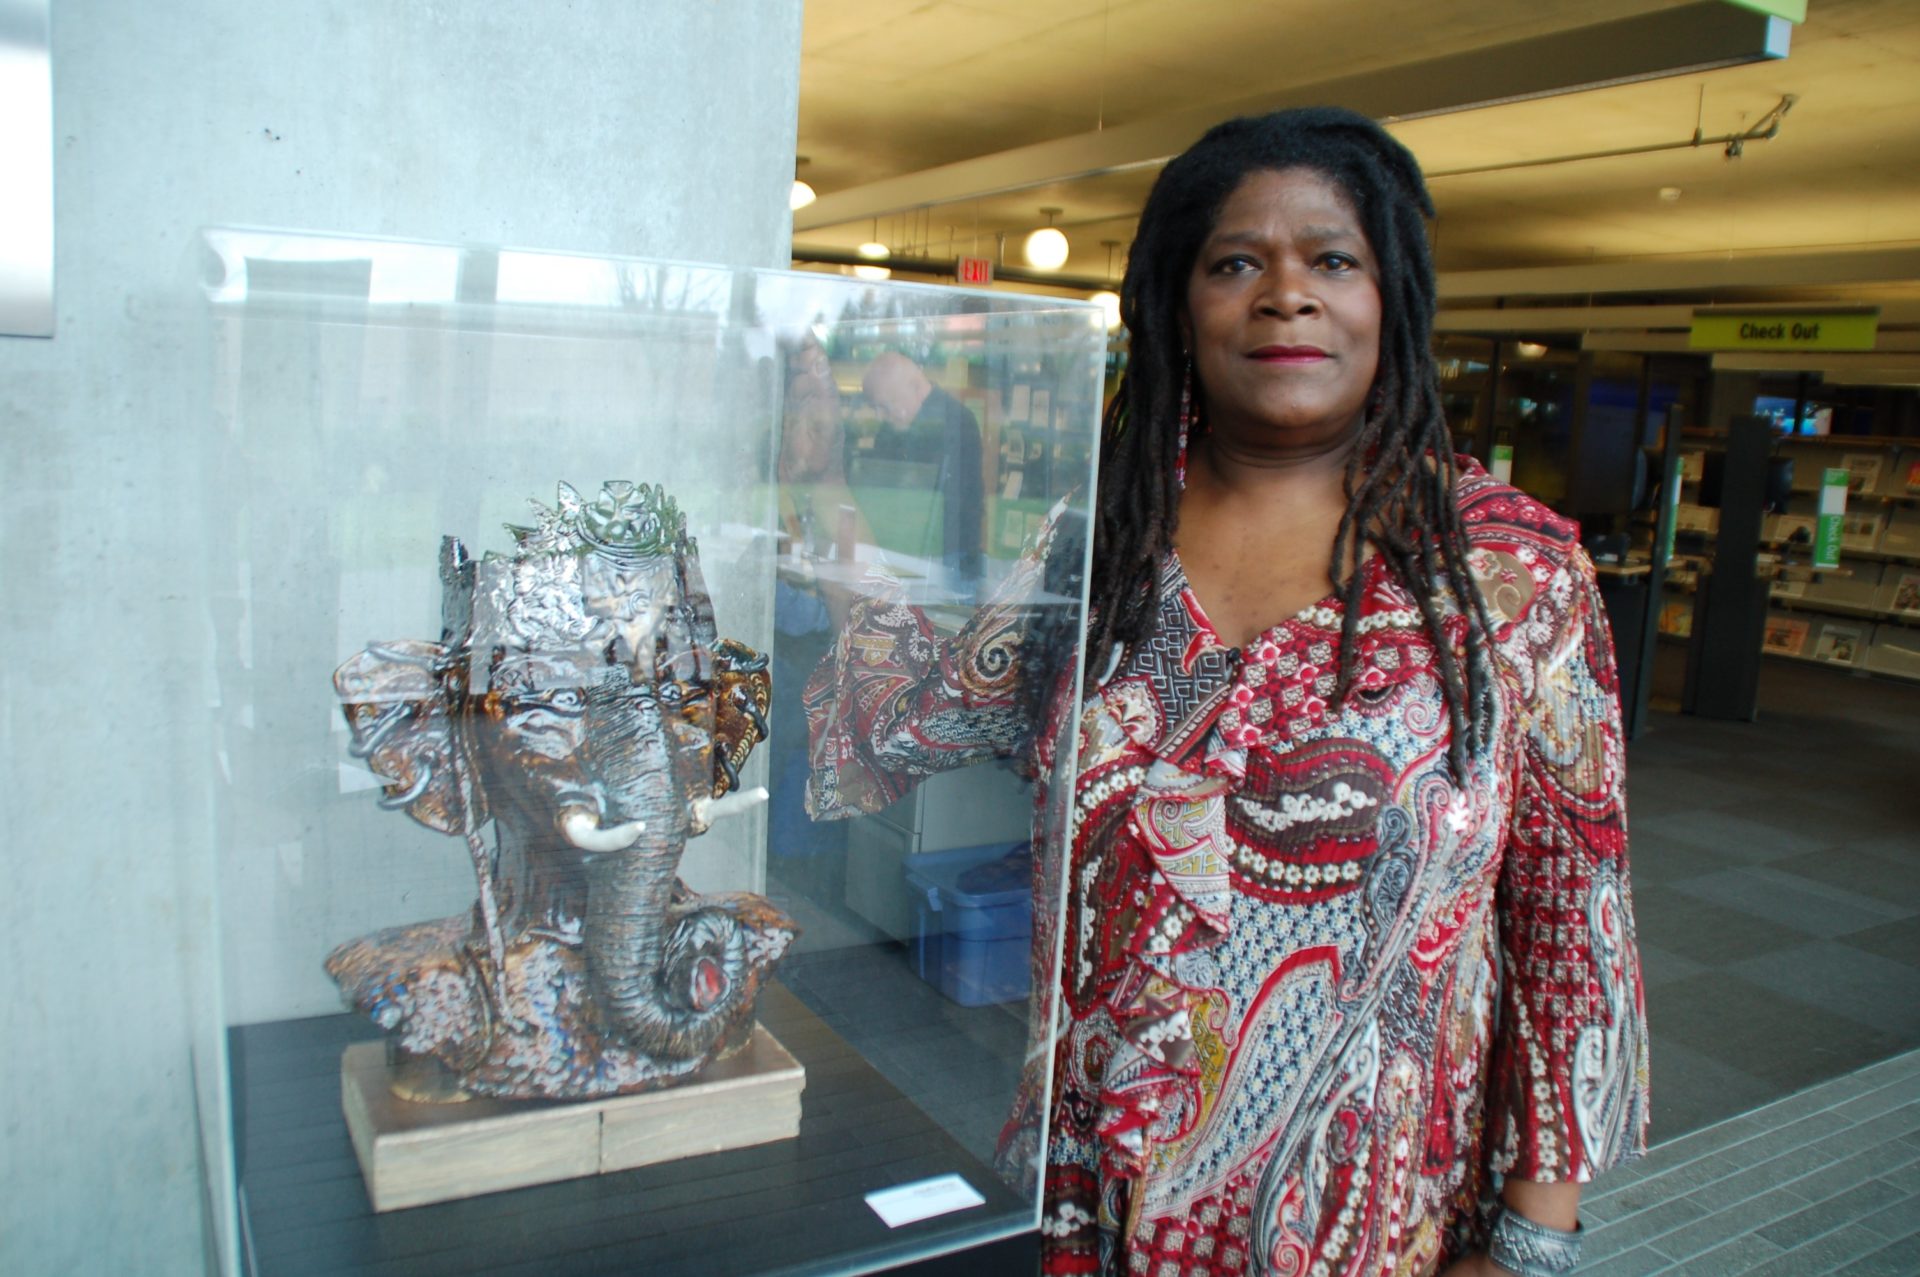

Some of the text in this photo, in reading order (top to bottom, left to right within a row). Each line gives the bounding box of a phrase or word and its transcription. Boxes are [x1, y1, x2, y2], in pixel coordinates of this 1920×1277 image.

[964, 259, 989, 283] EXIT
[1740, 322, 1820, 340] Check Out
